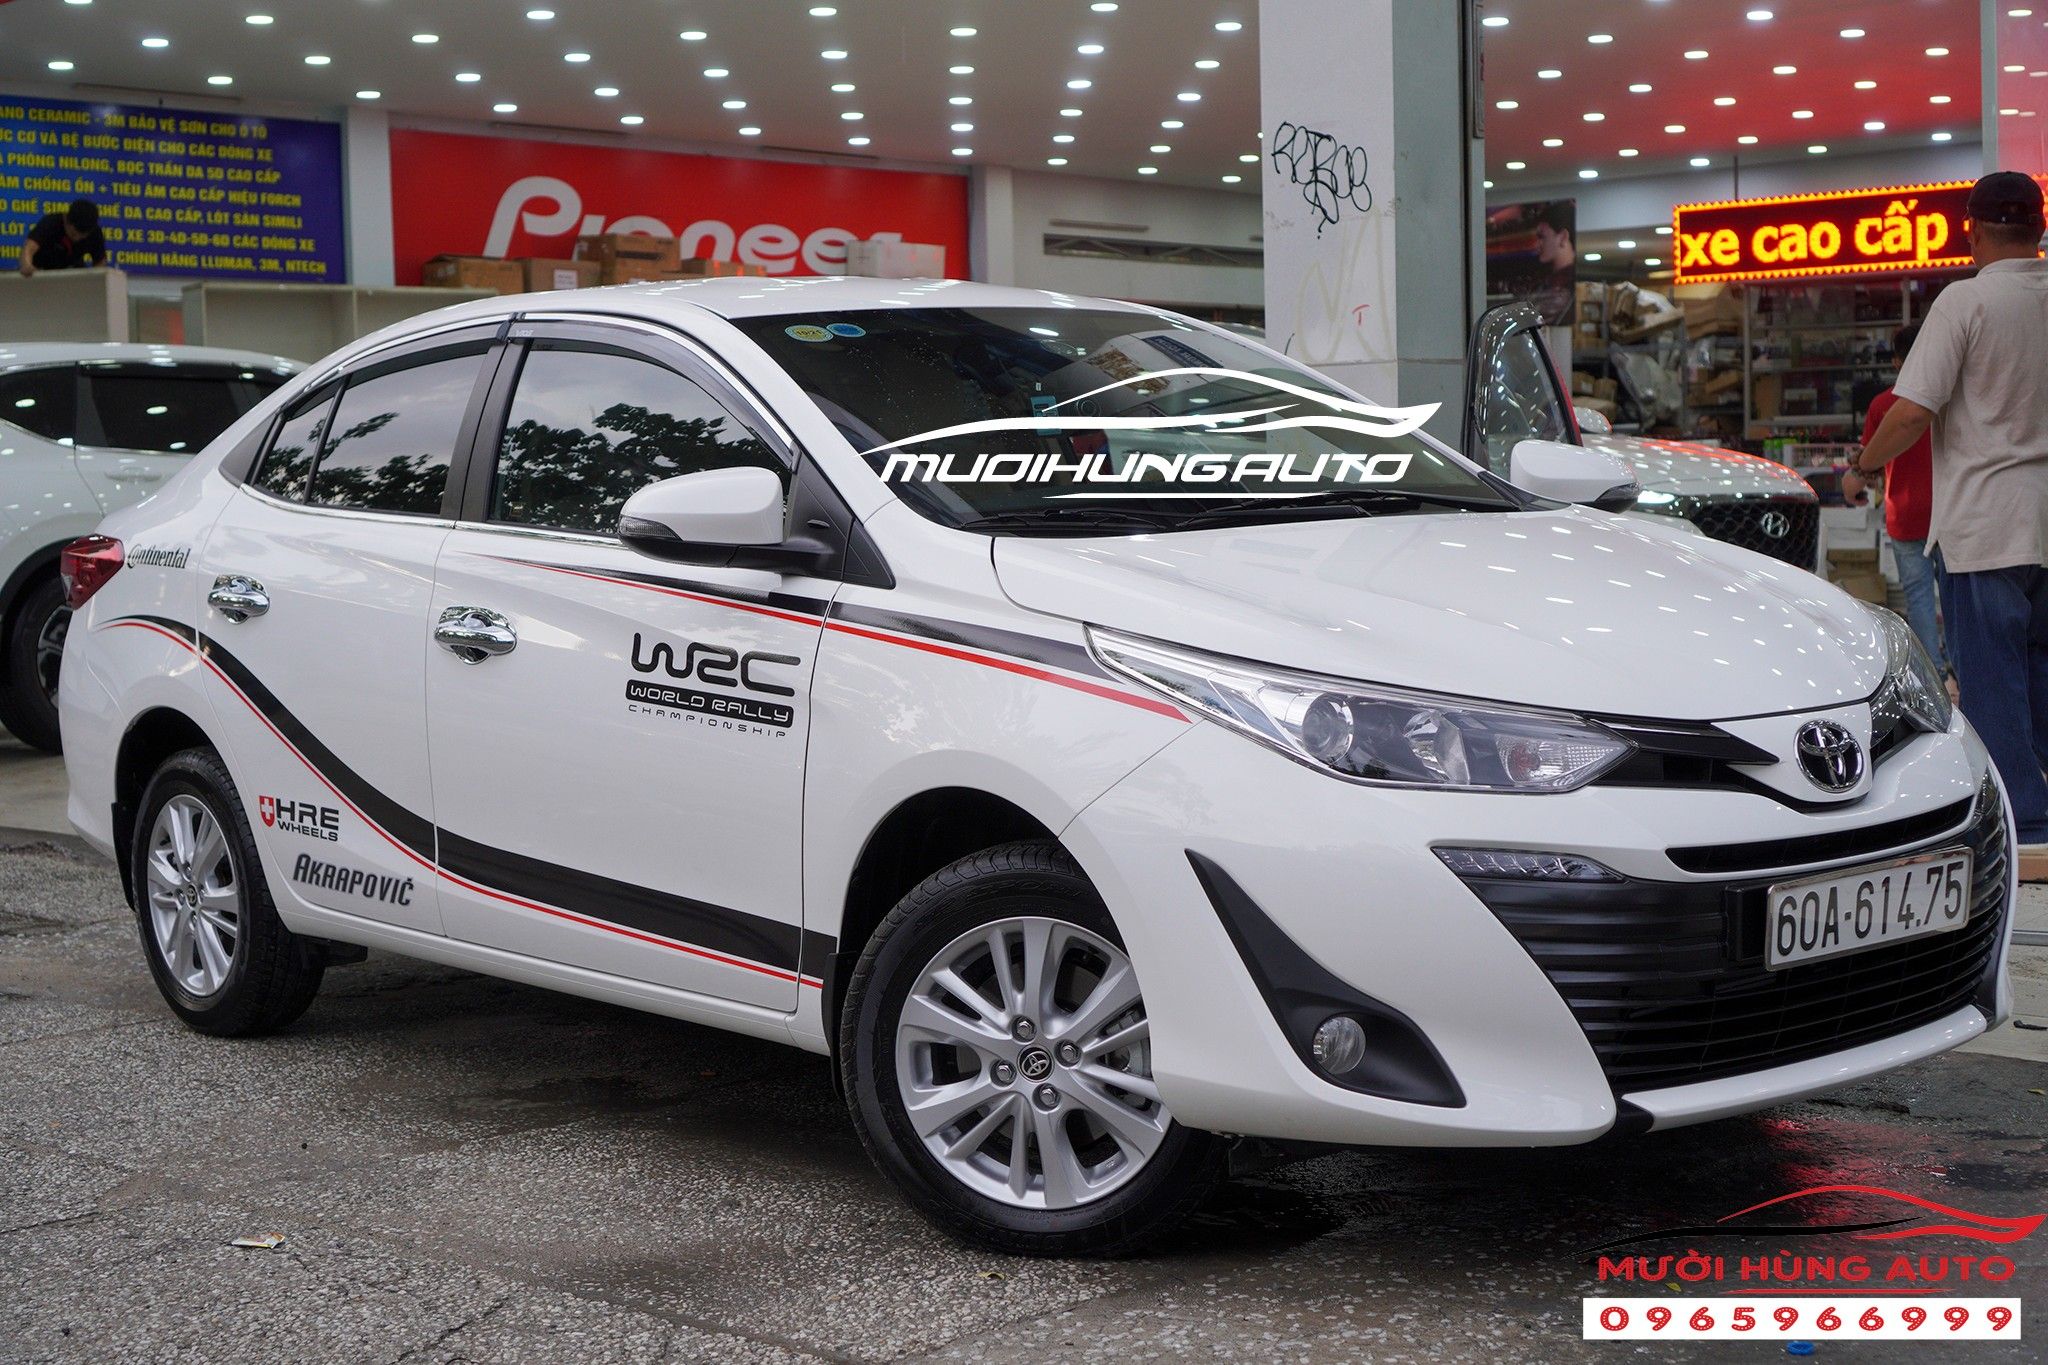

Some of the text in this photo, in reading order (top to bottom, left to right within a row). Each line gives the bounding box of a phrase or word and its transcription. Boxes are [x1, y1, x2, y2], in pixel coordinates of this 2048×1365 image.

[28, 108, 90, 125] CERAMIC
[104, 113, 125, 128] 3M
[210, 123, 236, 137] CHO
[159, 140, 185, 154] CHO
[257, 148, 273, 162] XE
[186, 166, 204, 179] DA
[207, 166, 224, 180] 5D
[227, 168, 253, 182] CAO
[169, 186, 196, 201] CAO
[124, 205, 142, 219] DA
[145, 207, 173, 221] CAO
[127, 229, 144, 243] XE
[299, 238, 315, 252] XE
[1681, 198, 1949, 268] xe cao cấp
[127, 543, 191, 569] Continental
[630, 632, 801, 697] WRC
[629, 684, 789, 722] WORLD RALLY
[628, 704, 786, 738] CHAMPIONSHIP
[276, 798, 339, 831] HRE
[278, 820, 338, 842] WHEELS
[1777, 861, 1965, 956] 60A-614.75
